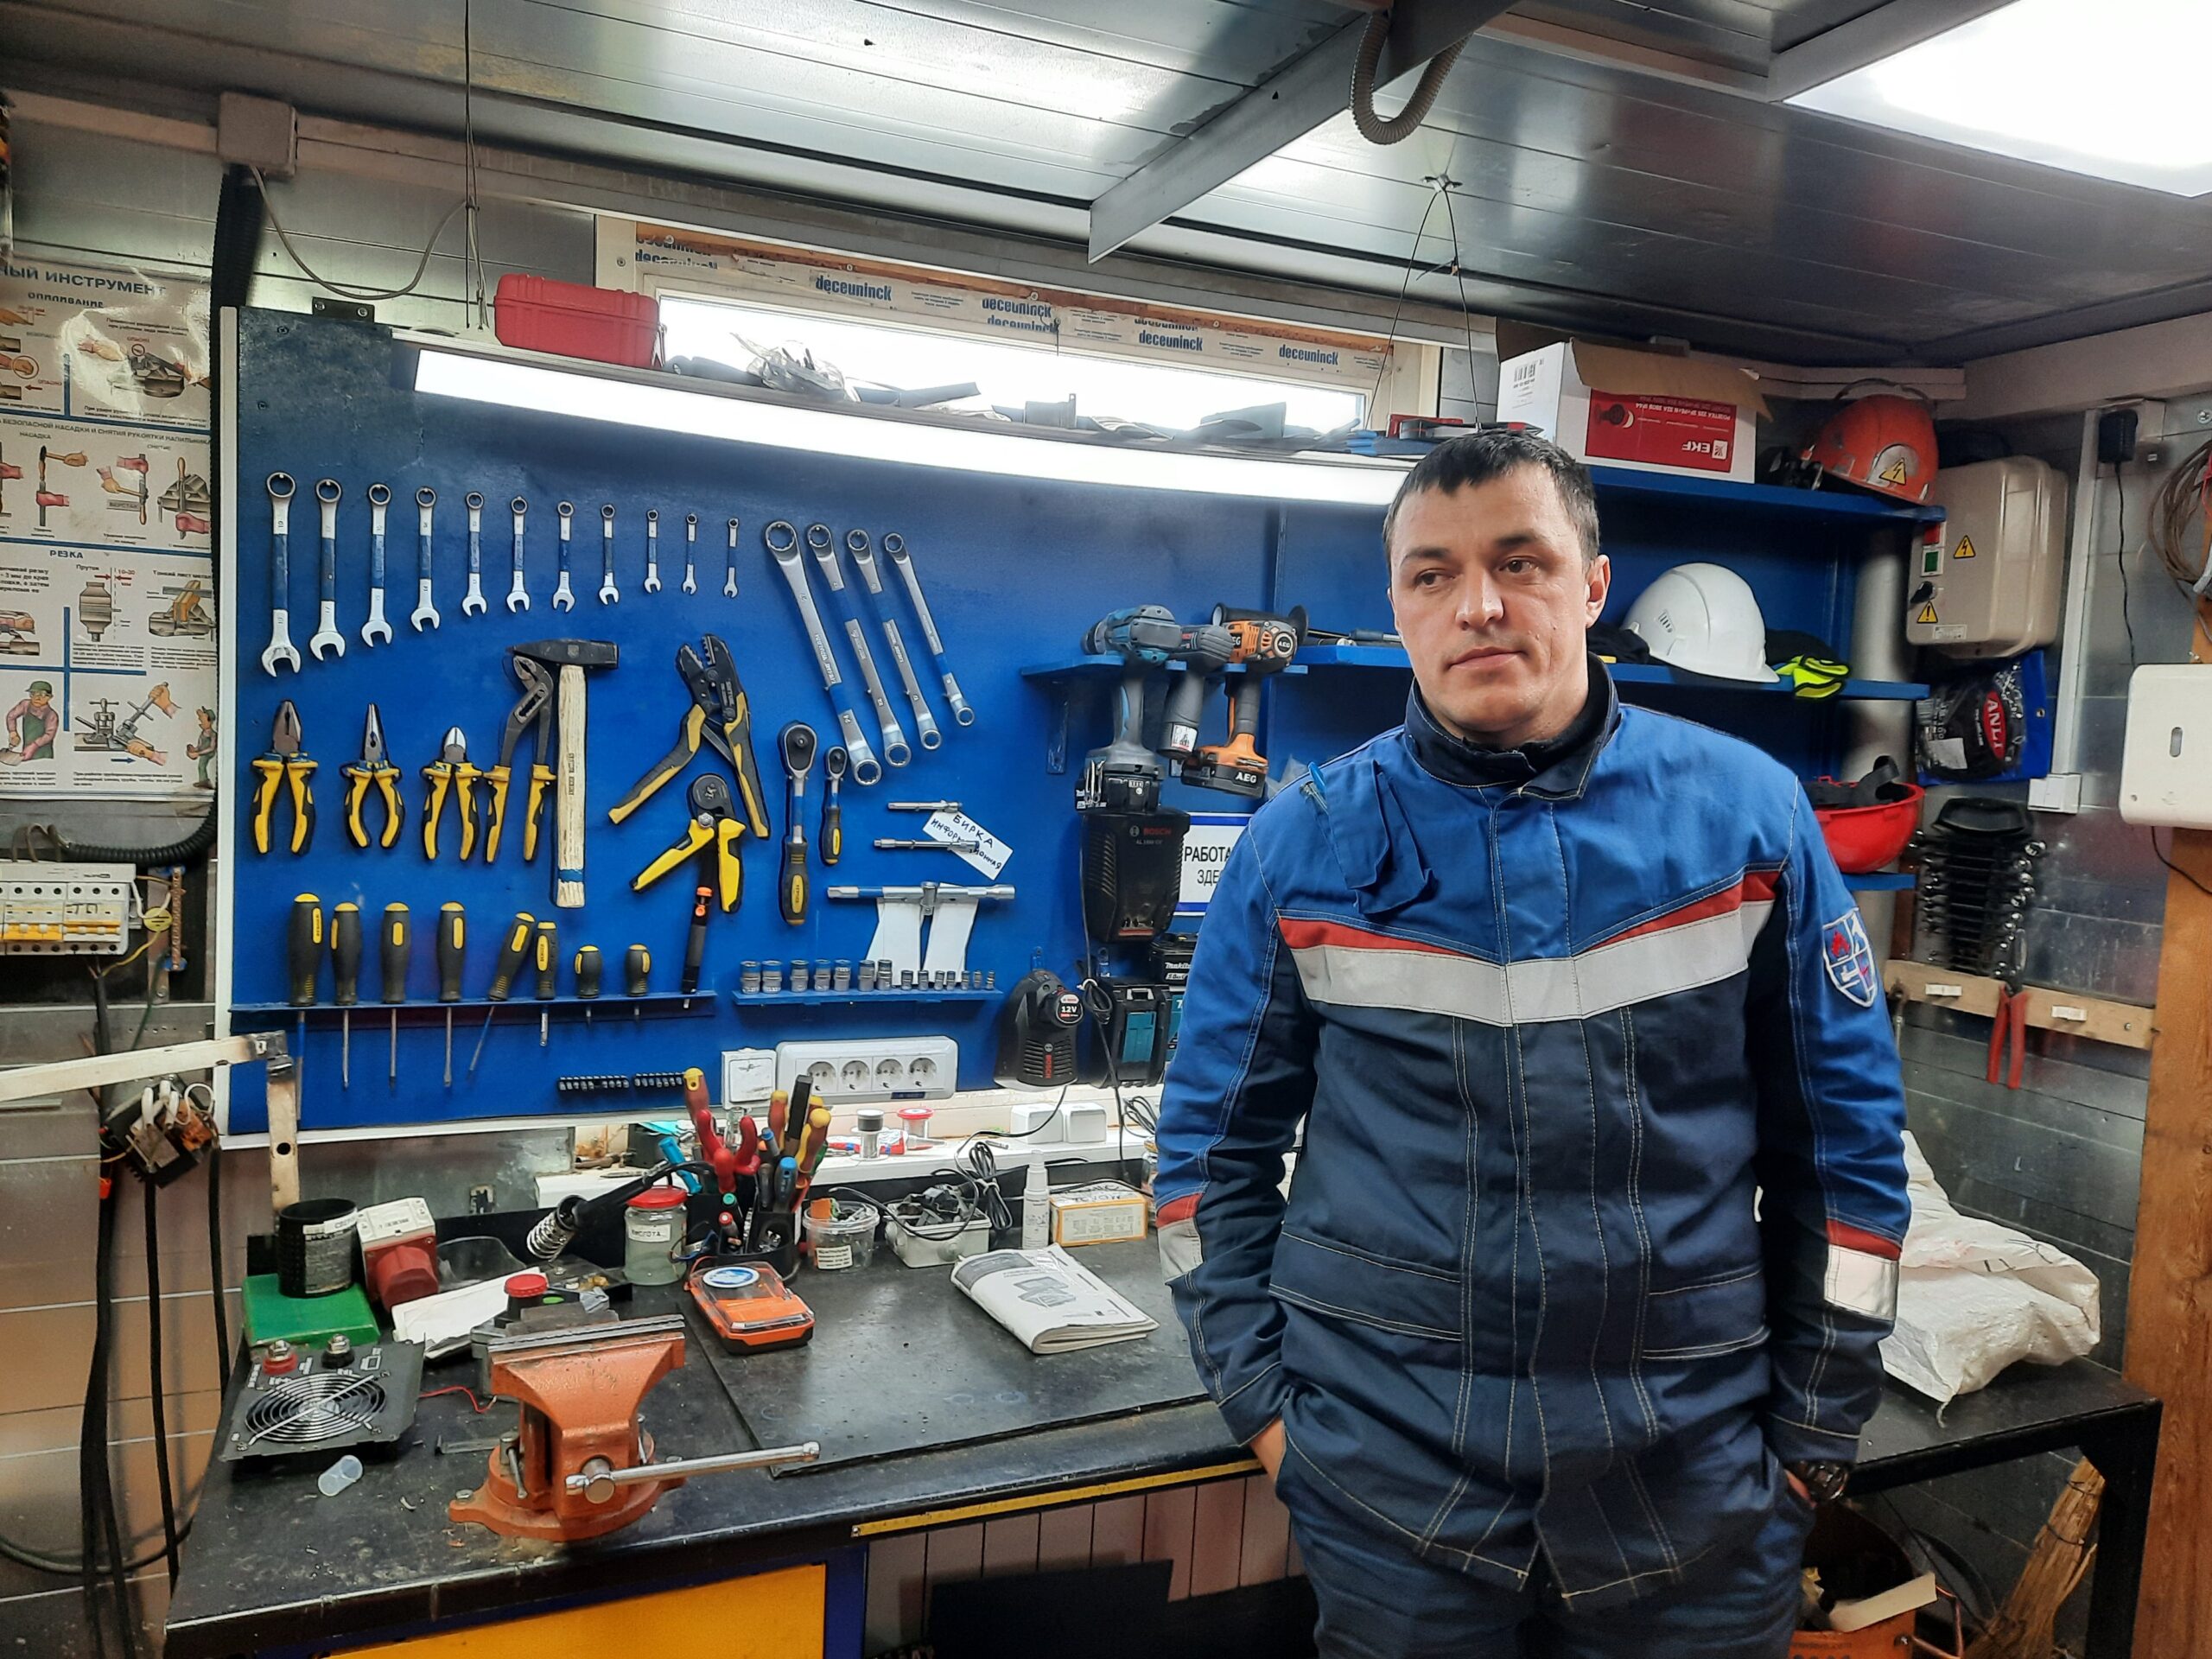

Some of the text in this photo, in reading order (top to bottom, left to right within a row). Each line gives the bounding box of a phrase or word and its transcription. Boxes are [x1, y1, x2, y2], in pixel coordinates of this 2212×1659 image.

[45, 271, 167, 296] ИНСТРУМЕНТ
[815, 274, 892, 302] deceuninck
[1138, 329, 1204, 352] deceuninck
[1279, 344, 1338, 365] deceuninck
[1681, 441, 1711, 454] EKF
[49, 550, 84, 559] РЕЗКА
[1278, 639, 1291, 648] AEG
[1986, 697, 2003, 748] ANLI
[1235, 771, 1257, 784] AEG
[951, 813, 994, 849] БИРКА
[1142, 827, 1171, 836] BOSCH
